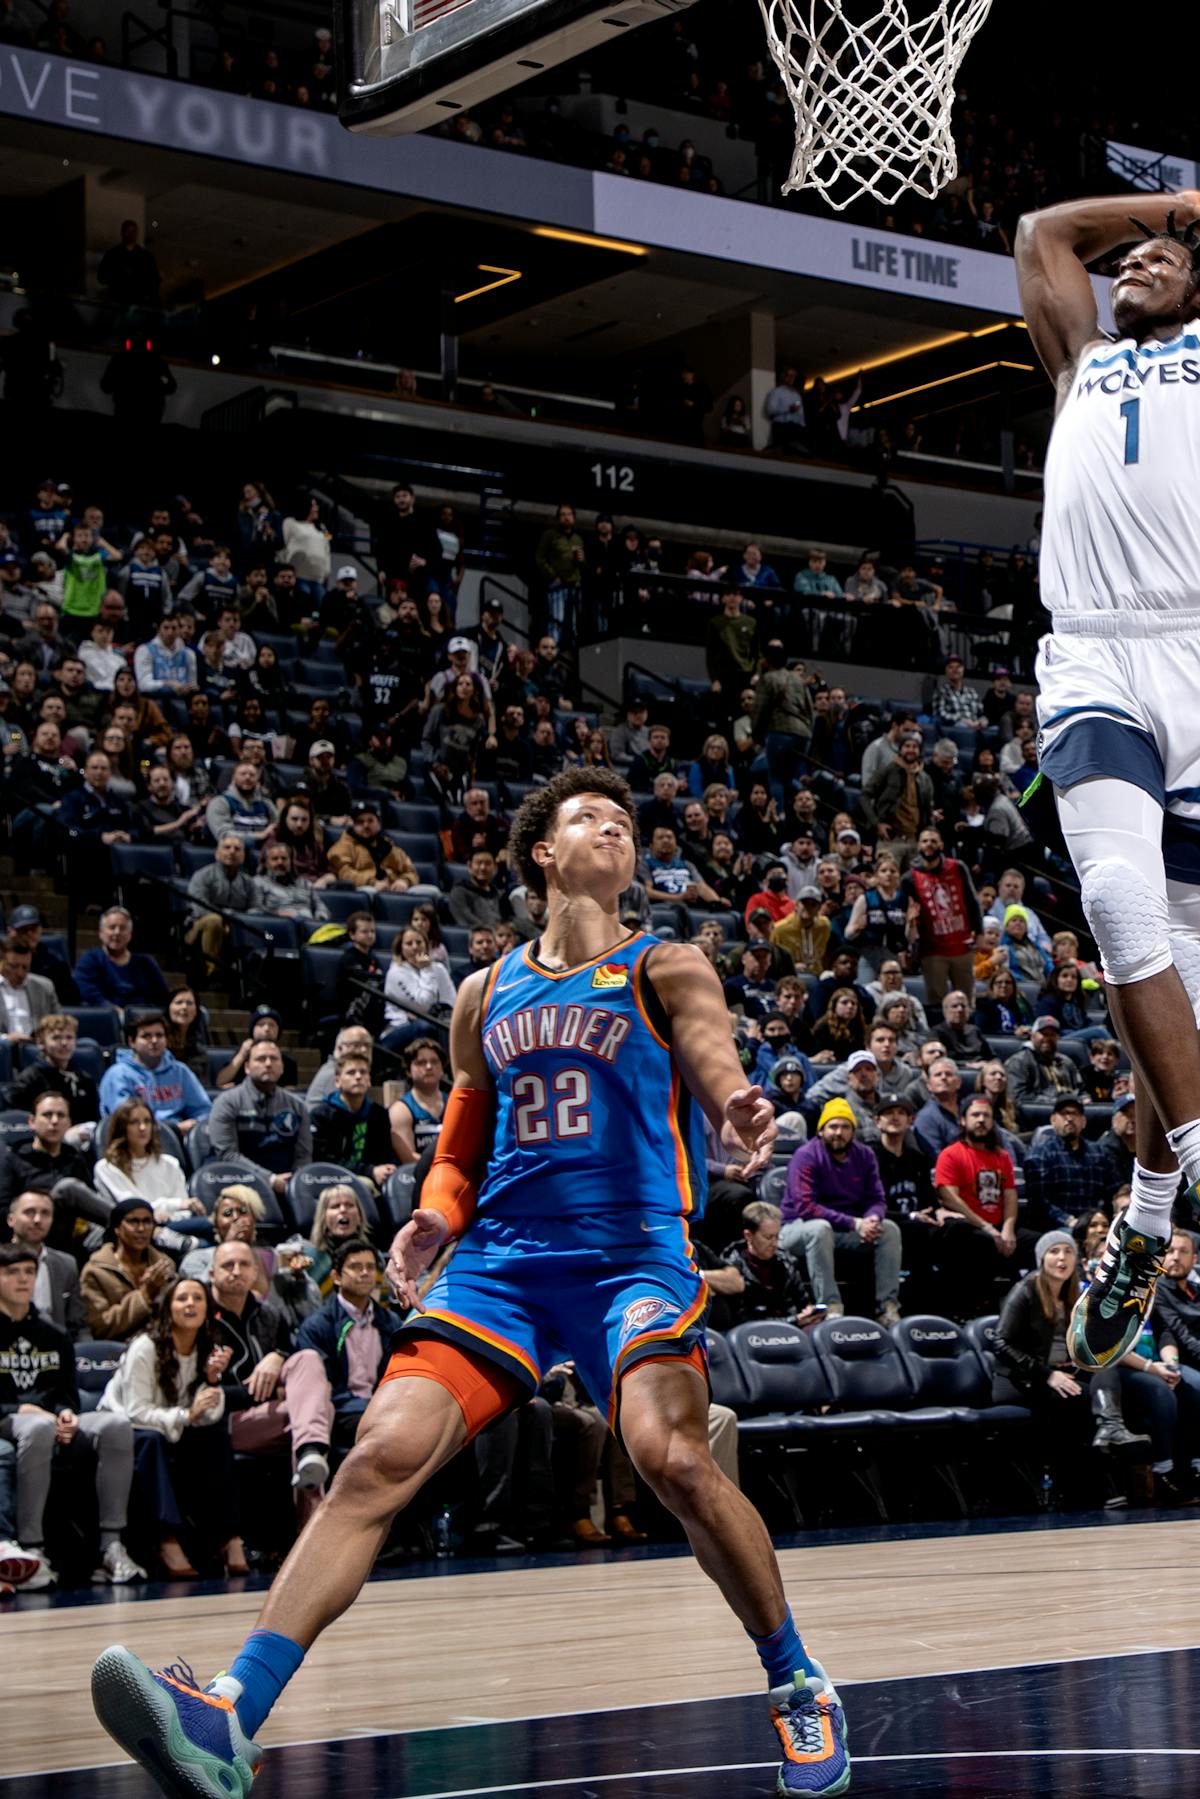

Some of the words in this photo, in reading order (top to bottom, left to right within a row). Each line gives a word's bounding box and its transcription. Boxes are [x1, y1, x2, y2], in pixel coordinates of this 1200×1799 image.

[0, 54, 100, 124] VE
[128, 78, 327, 168] YOUR
[852, 237, 898, 278] LIFE
[901, 247, 959, 288] TIME
[1120, 397, 1140, 465] 1
[591, 462, 635, 492] 112
[482, 1003, 633, 1072] THUNDER
[511, 1066, 592, 1147] 22
[762, 1335, 801, 1346] LEXUS
[843, 1331, 881, 1342] LEXUS
[924, 1330, 959, 1341] LEXUS
